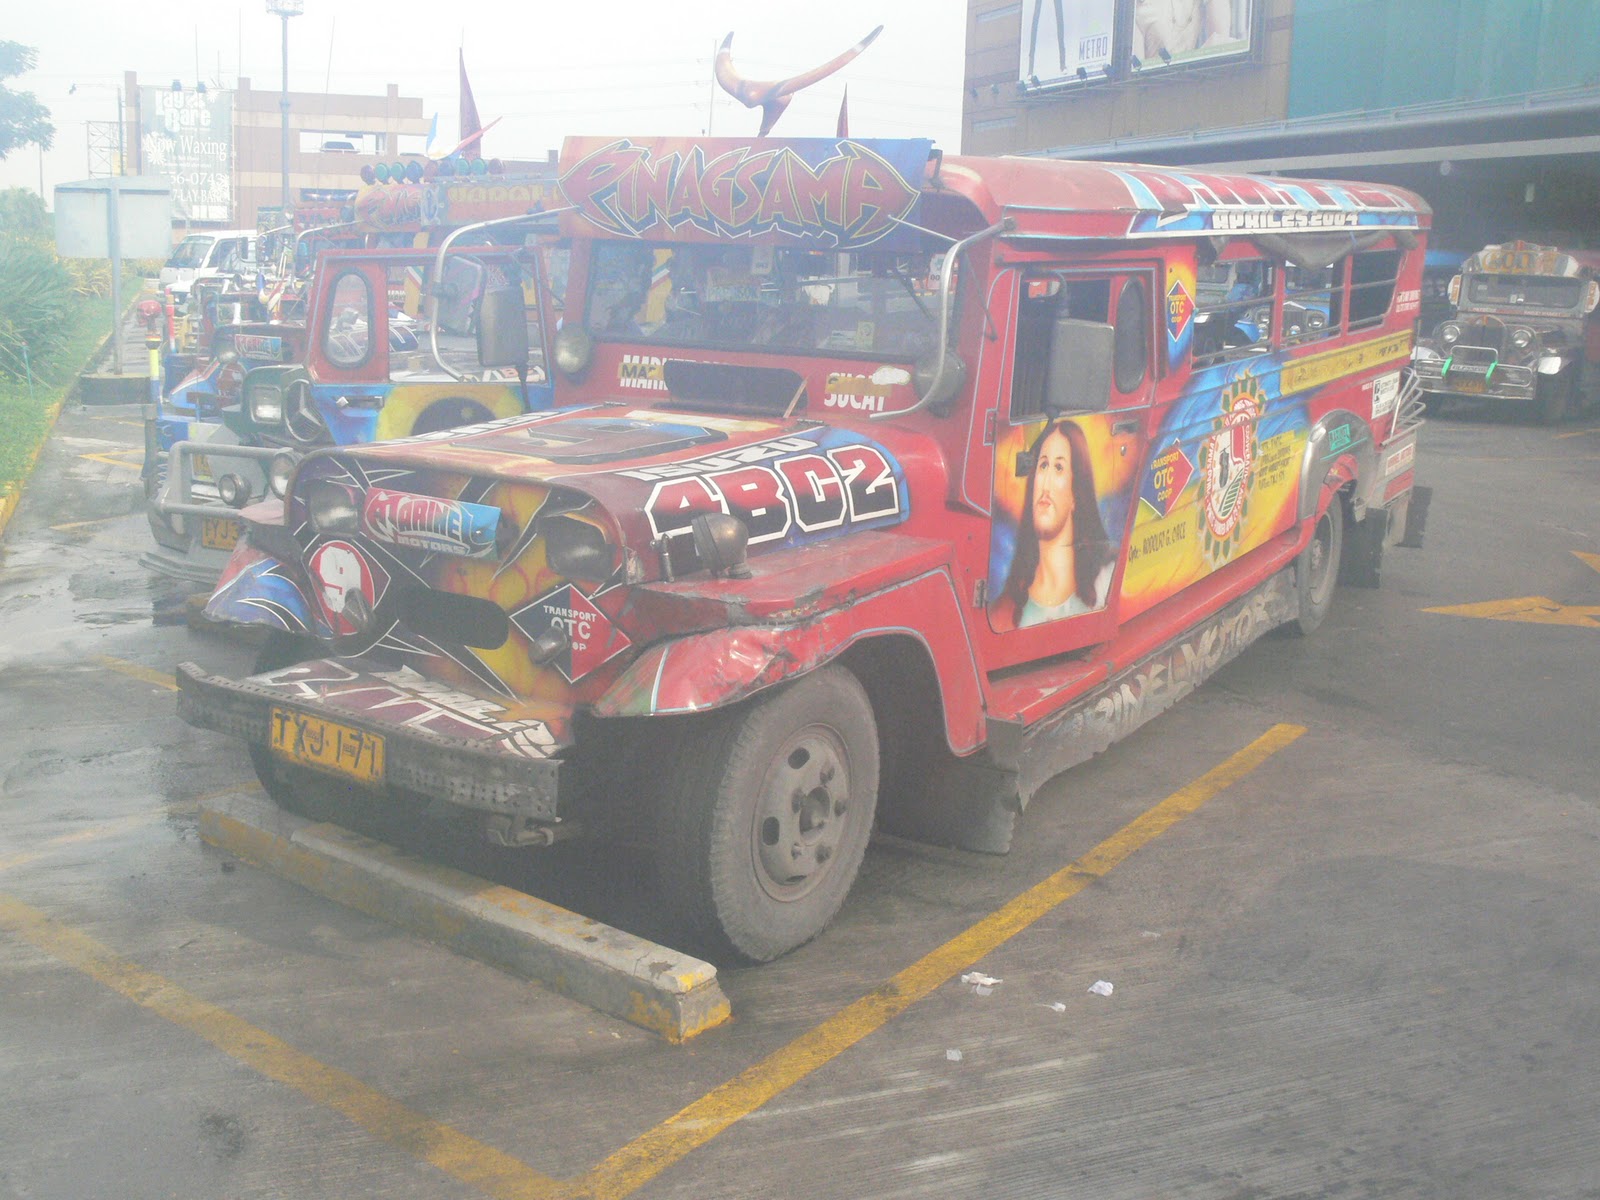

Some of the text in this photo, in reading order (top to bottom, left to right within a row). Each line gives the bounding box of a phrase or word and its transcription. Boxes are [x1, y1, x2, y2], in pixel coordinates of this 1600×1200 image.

[1079, 36, 1108, 60] METRO
[155, 90, 184, 115] Lay
[165, 108, 211, 132] Bare
[180, 135, 227, 161] Waxing
[559, 139, 921, 248] PINAGSAMA
[1169, 301, 1185, 315] OTC
[1151, 452, 1180, 470] TRANSPORT
[1154, 466, 1174, 490] OTC
[397, 535, 471, 556] MOTORS
[319, 545, 361, 613] 9
[542, 604, 597, 622] TRANSPORT
